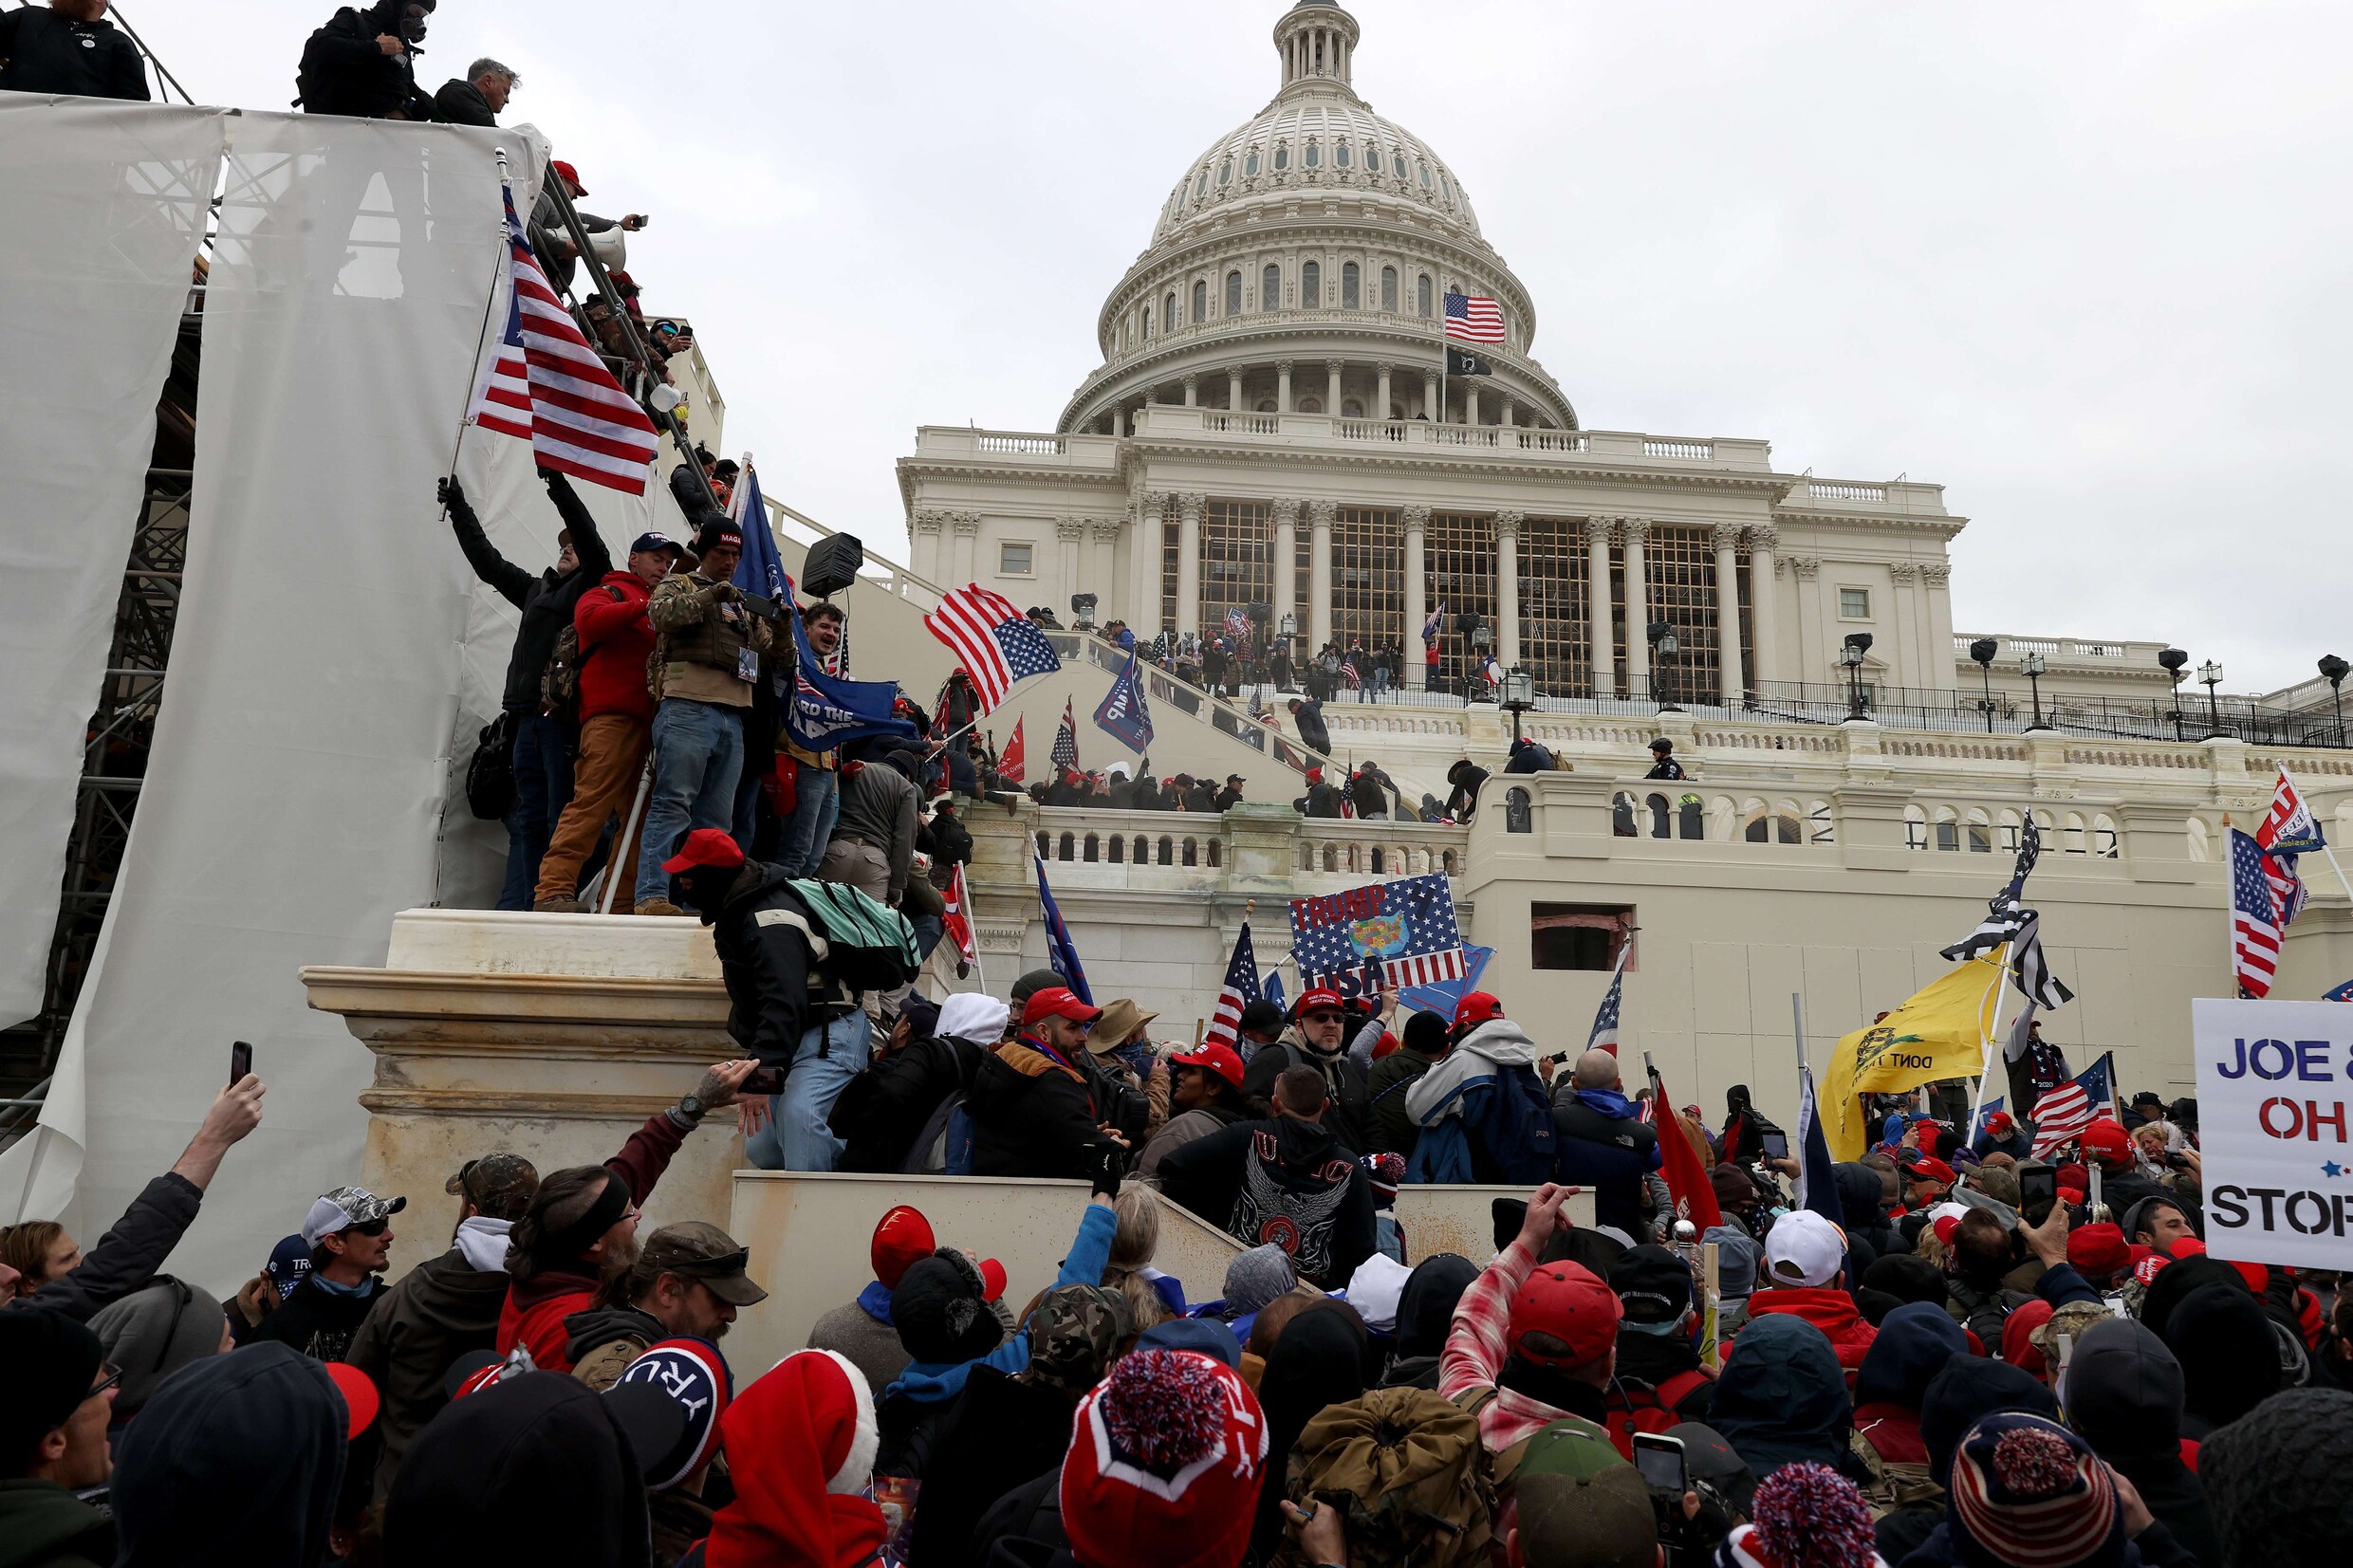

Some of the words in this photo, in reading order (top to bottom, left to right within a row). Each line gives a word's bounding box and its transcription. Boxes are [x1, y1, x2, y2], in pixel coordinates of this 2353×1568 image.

[721, 534, 741, 544] MAGA
[824, 706, 853, 721] THE
[1289, 884, 1387, 932] TRUMP
[1301, 955, 1385, 1000] USA
[2216, 1038, 2334, 1082] JOE
[2259, 1097, 2347, 1143] OH
